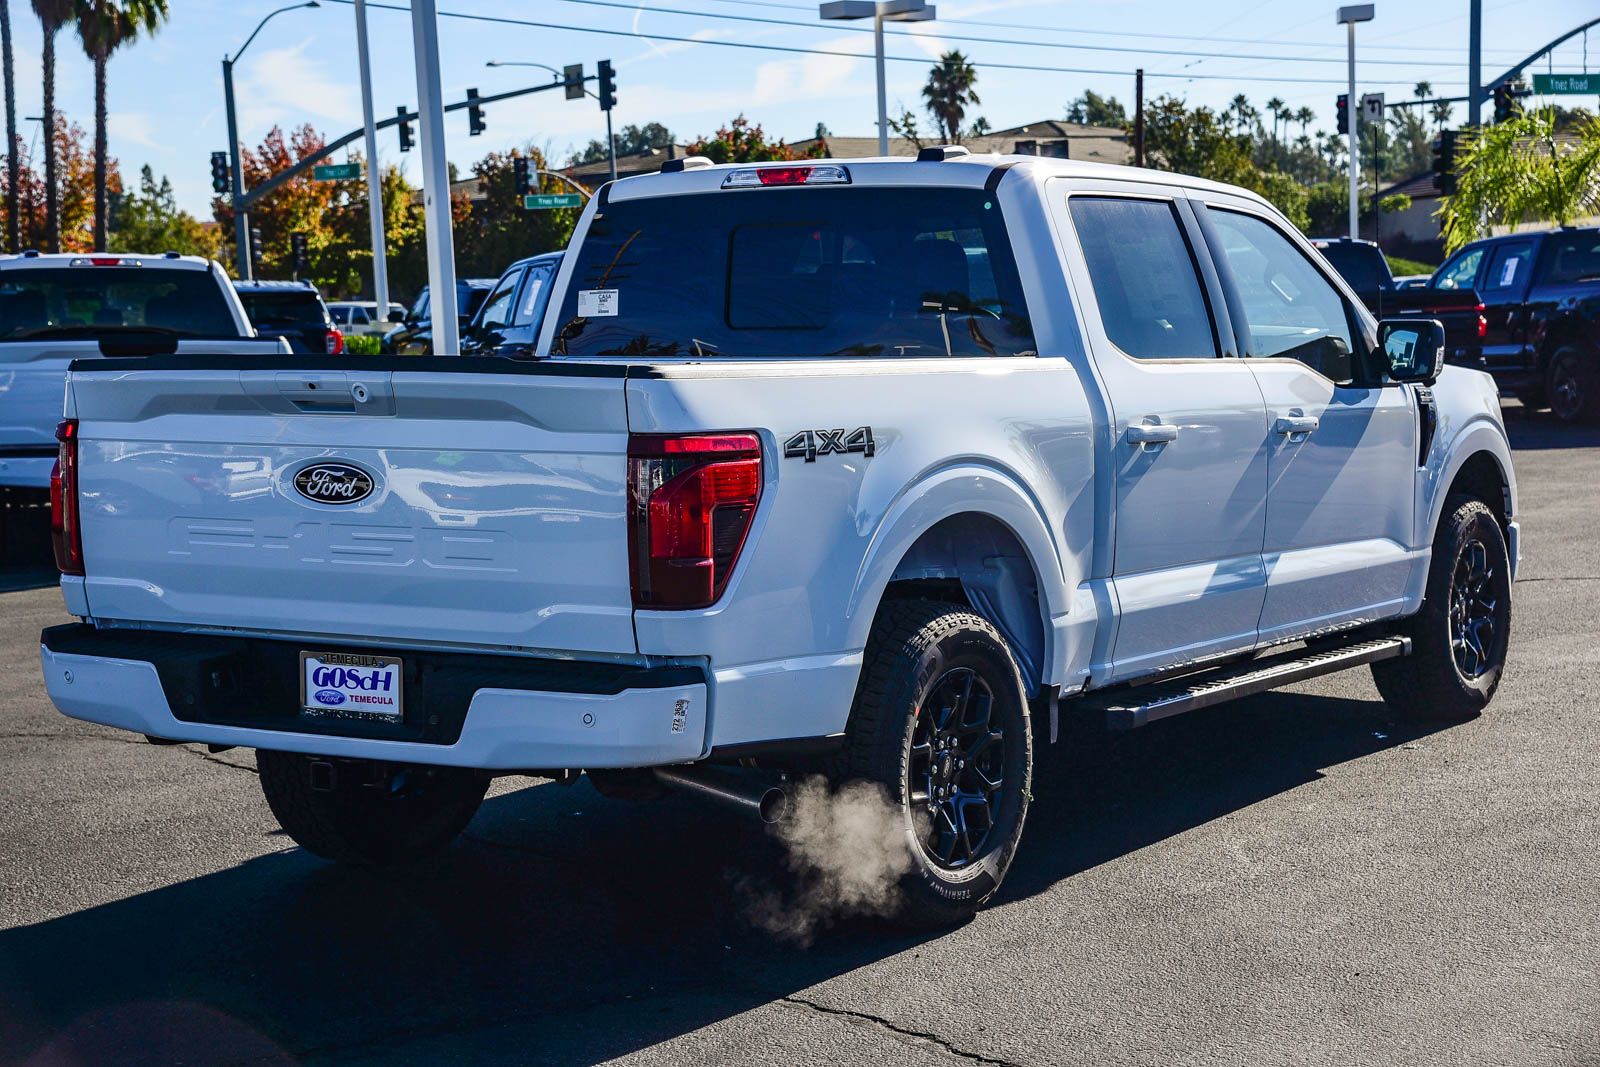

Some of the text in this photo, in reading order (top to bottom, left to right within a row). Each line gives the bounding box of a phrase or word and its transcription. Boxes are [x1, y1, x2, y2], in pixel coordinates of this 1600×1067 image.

[1569, 77, 1588, 90] Road
[783, 426, 875, 463] 4x4
[306, 469, 359, 497] Ford
[324, 653, 378, 666] TEMECULA
[319, 691, 394, 706] Ford TEMECULA
